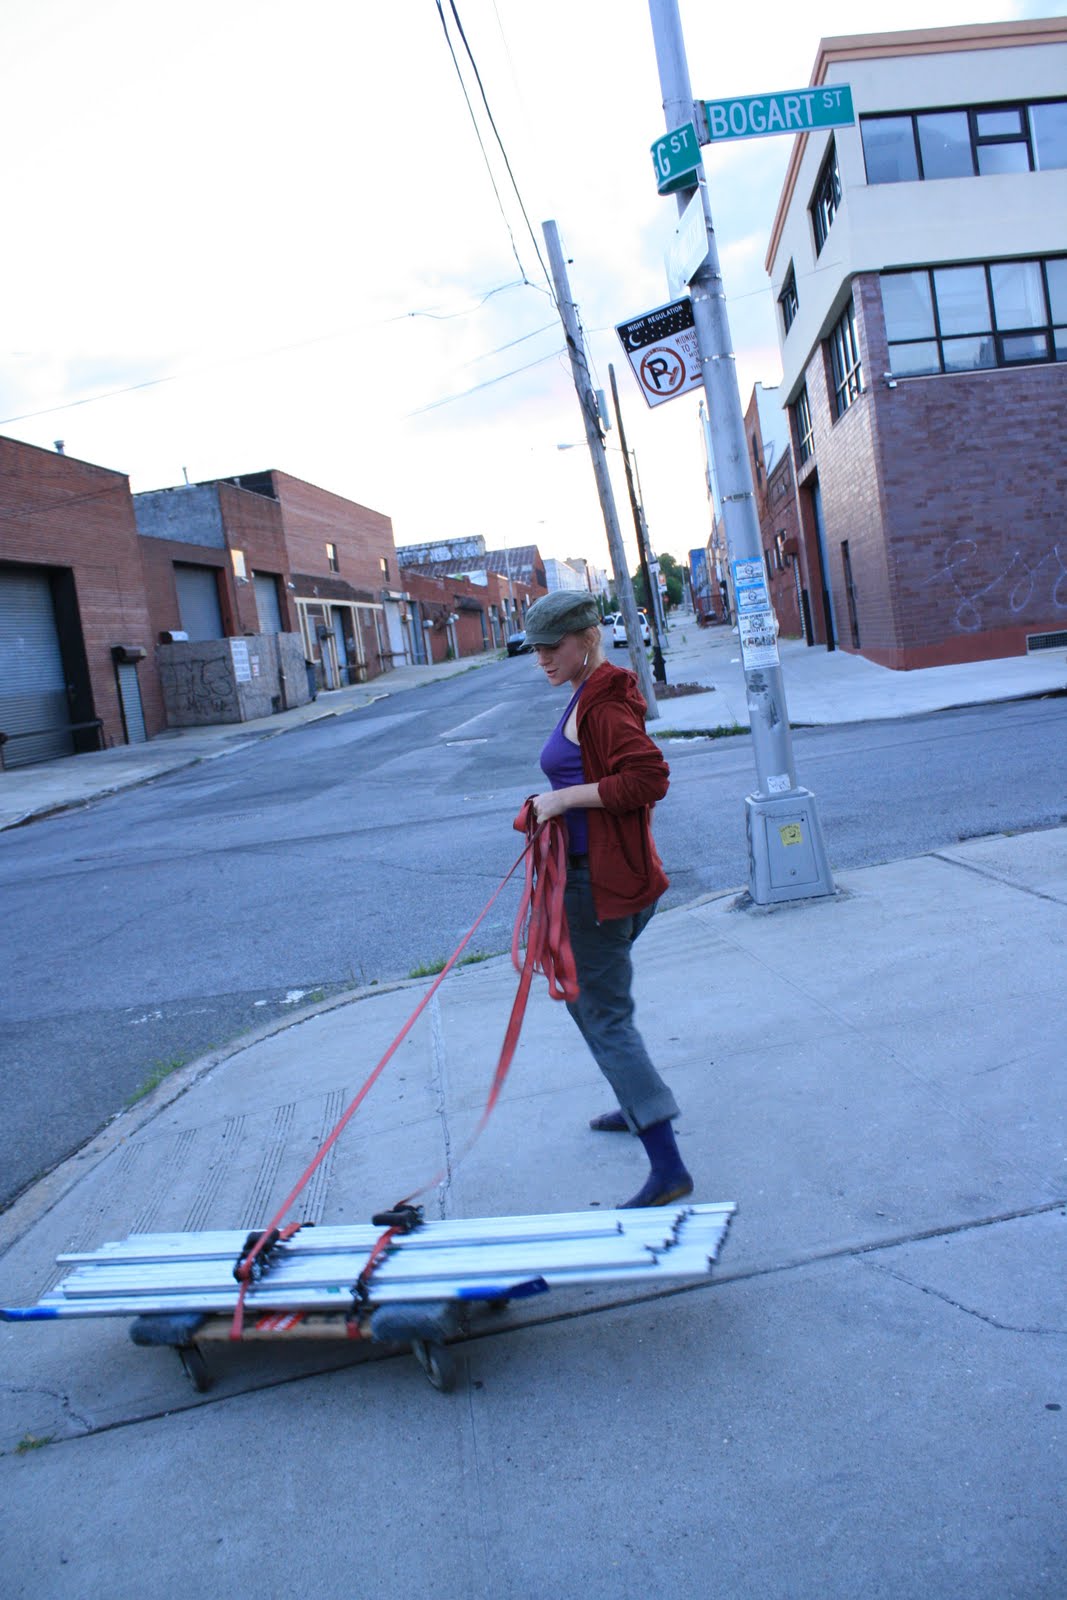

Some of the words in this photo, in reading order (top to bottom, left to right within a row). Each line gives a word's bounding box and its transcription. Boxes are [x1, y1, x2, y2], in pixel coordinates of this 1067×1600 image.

[709, 94, 815, 137] BOGART
[823, 90, 843, 109] ST
[670, 129, 688, 153] ST
[627, 320, 645, 332] NIGHT
[648, 305, 683, 323] REGULATION
[681, 343, 690, 353] TO
